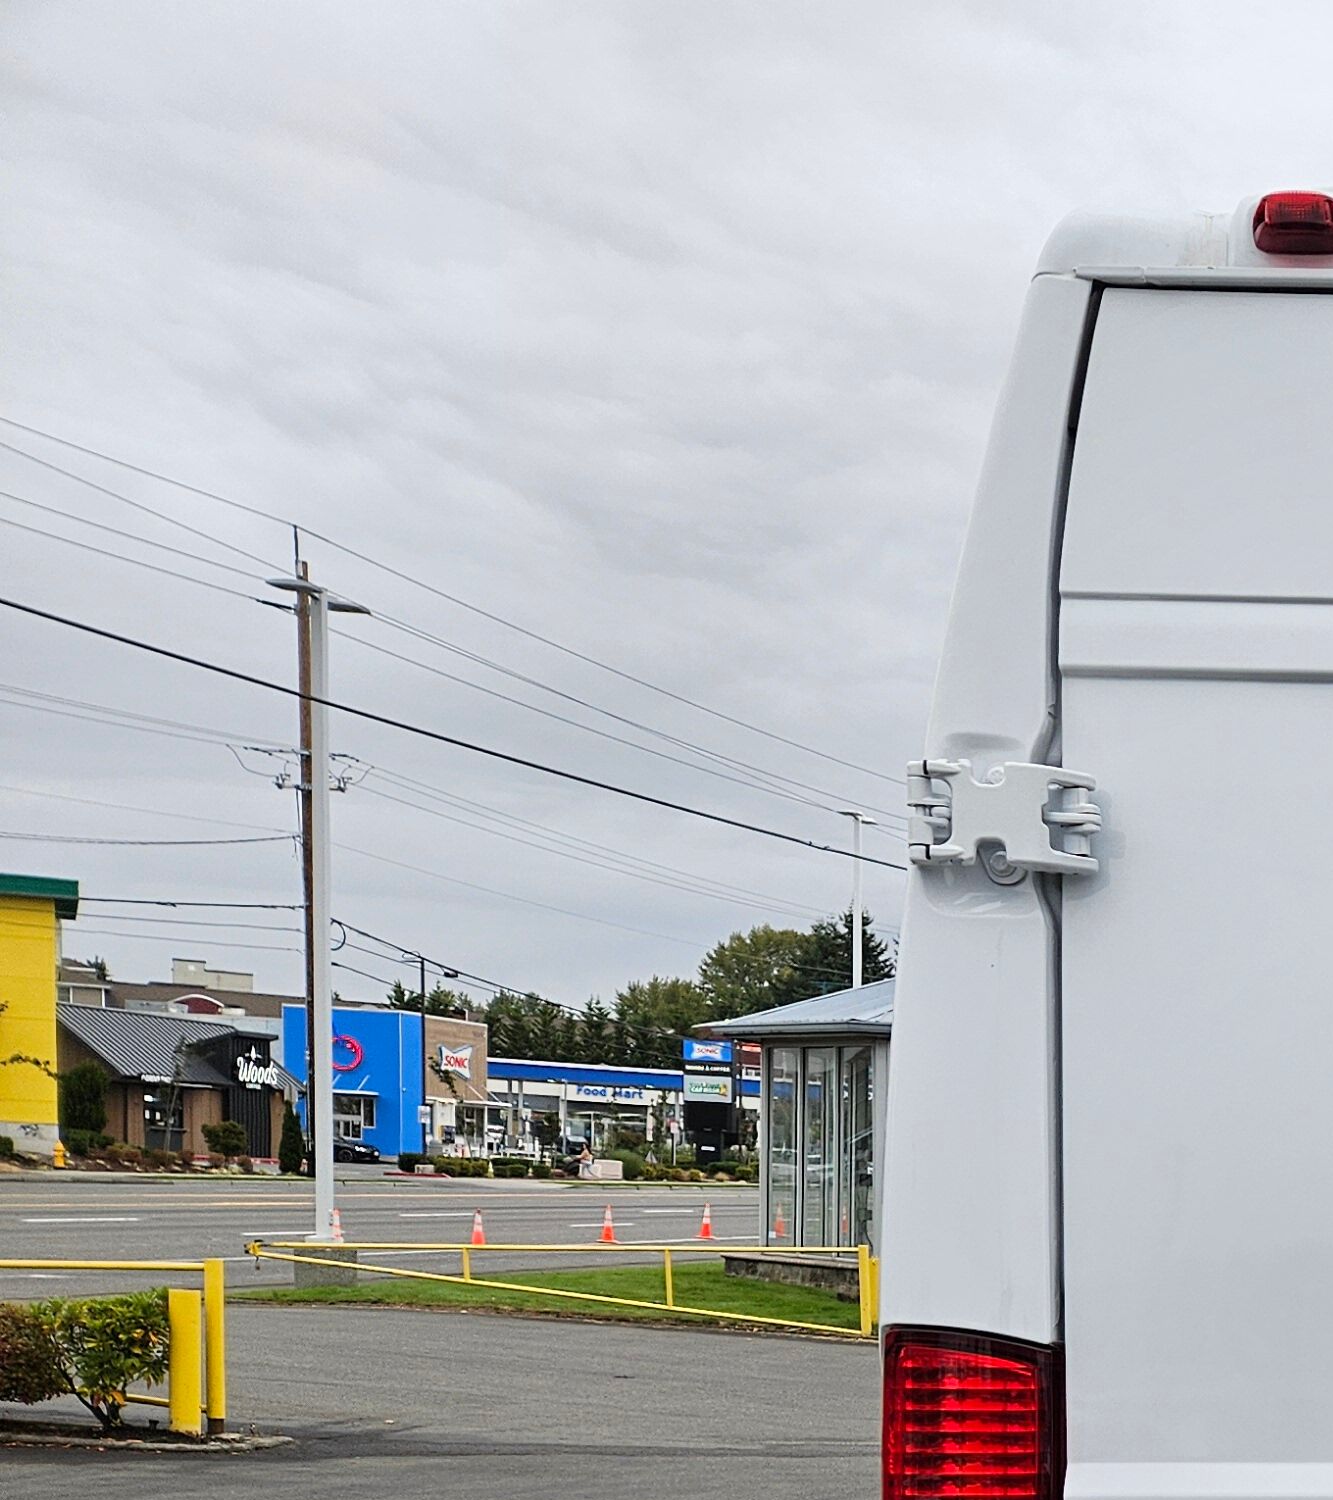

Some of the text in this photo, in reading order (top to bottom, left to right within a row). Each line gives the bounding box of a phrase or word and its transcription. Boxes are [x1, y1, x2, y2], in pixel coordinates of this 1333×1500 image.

[444, 1055, 468, 1068] SONIC
[236, 1056, 278, 1085] Woods
[576, 1084, 607, 1097] Food
